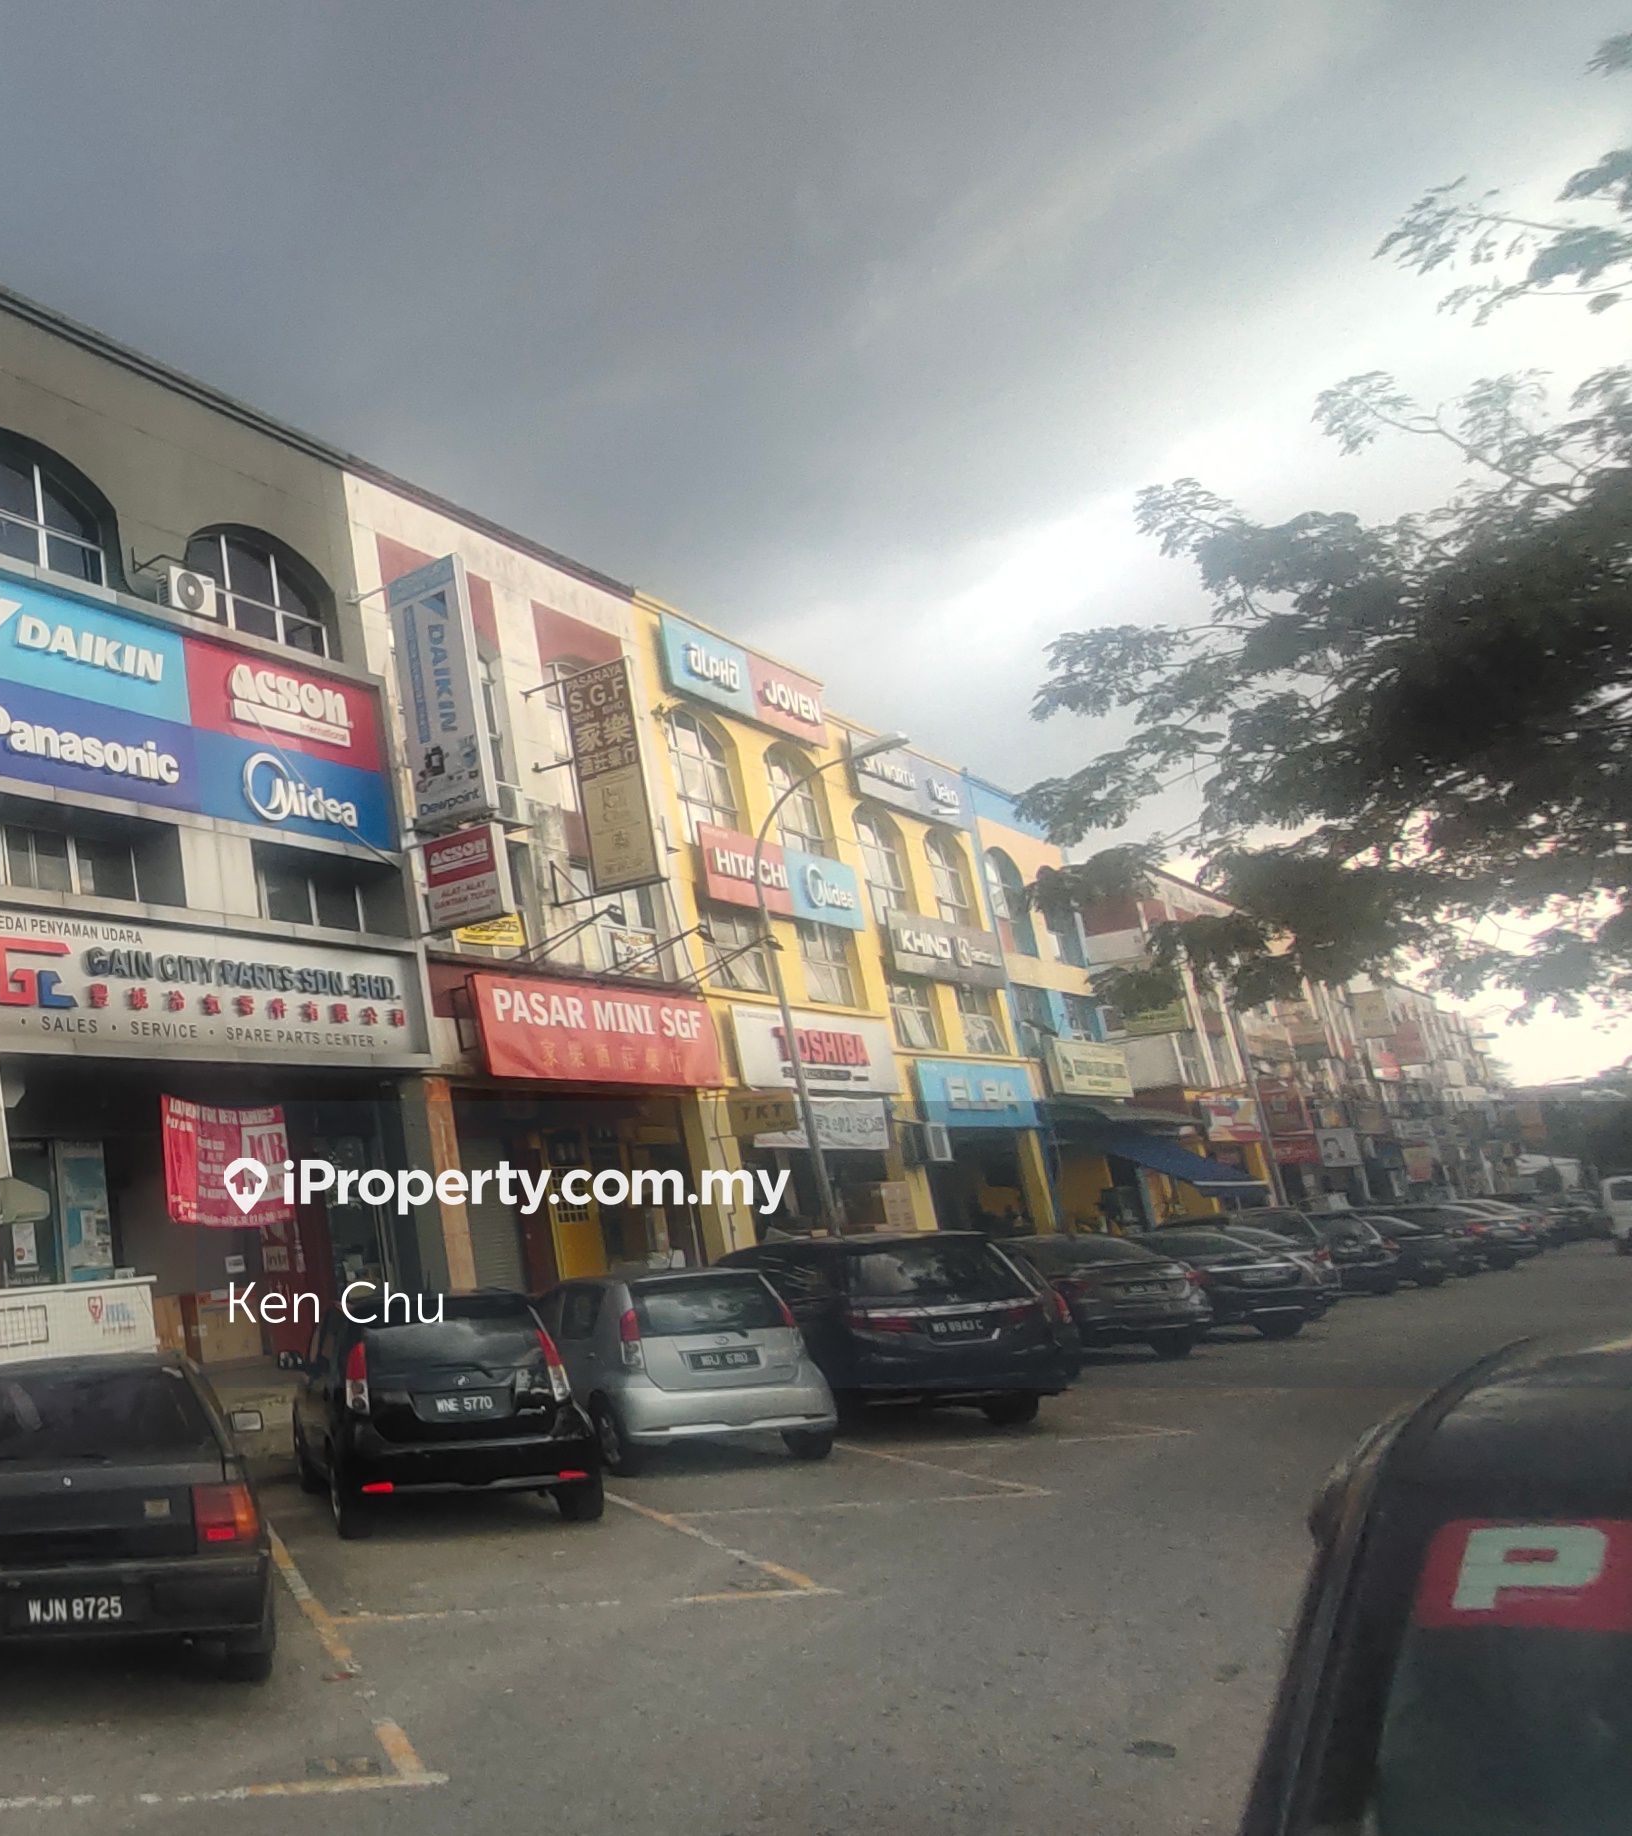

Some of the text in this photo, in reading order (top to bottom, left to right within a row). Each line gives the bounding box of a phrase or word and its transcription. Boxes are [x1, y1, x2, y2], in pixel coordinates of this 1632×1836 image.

[17, 615, 164, 683] DAIKIN
[428, 623, 458, 733] DAIKIN
[766, 678, 822, 725] JOVEN
[254, 766, 359, 829] Midea
[420, 790, 481, 816] Dewpoint
[712, 846, 790, 890] HITACHI
[30, 917, 100, 940] PENYAMAN
[101, 926, 143, 945] UDARA
[898, 926, 953, 959] KHIND
[84, 947, 153, 982] GAIN
[161, 956, 214, 984] CITY
[218, 961, 296, 991] PARTS
[41, 1015, 375, 1047] SALES SERVICE SPARE PARTS CENTER
[492, 988, 701, 1039] PASAR MINI SGF
[771, 1026, 870, 1067] TOSHIBA
[463, 1394, 494, 1411] 5770
[1452, 1525, 1608, 1611] P
[28, 1596, 122, 1623] WJN 8725
